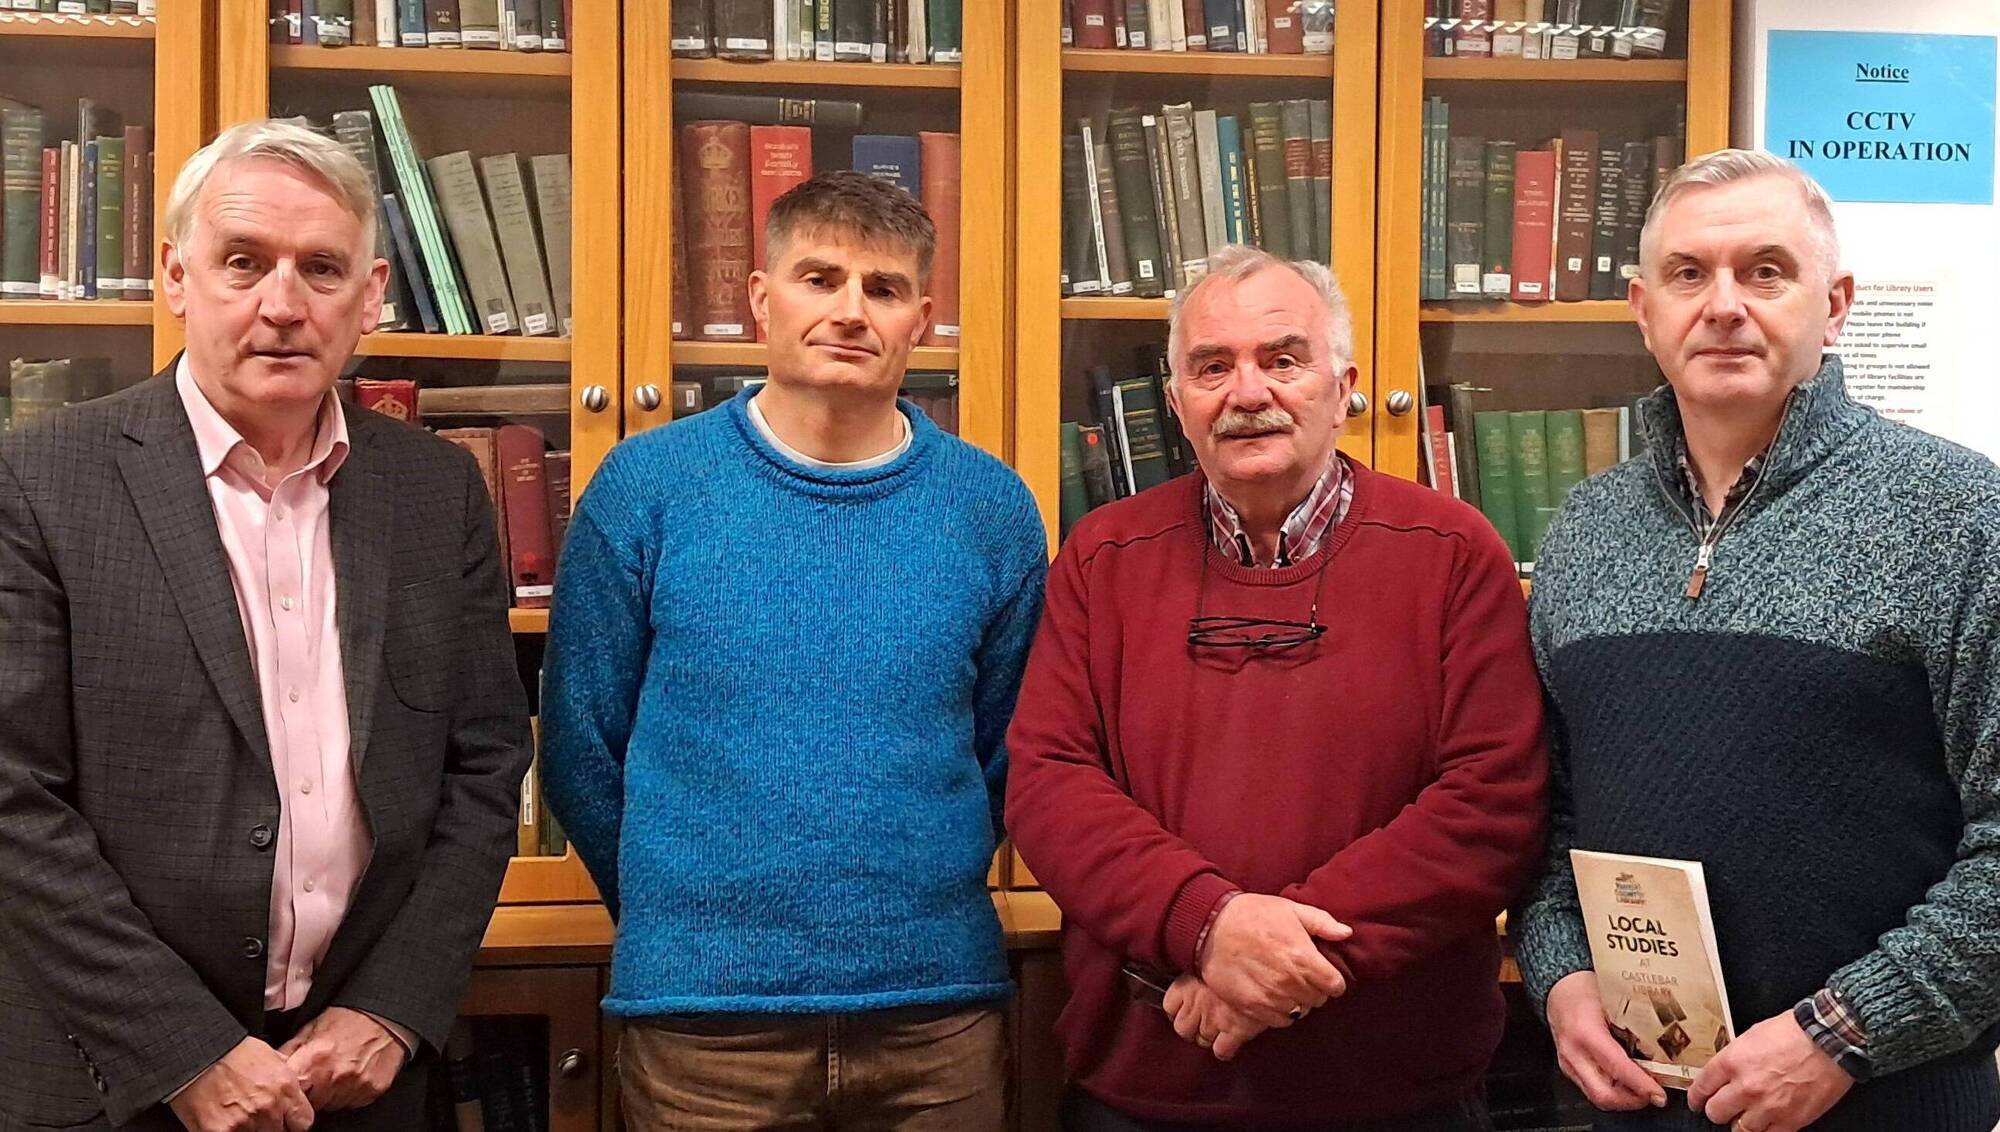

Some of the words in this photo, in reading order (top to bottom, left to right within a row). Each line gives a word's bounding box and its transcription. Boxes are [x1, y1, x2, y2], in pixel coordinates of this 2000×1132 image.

[1856, 63, 1910, 83] Notice
[1846, 111, 1916, 131] CCTV
[1788, 140, 1815, 159] IN
[1822, 140, 1972, 162] OPERATION
[1886, 284, 1912, 293] Library
[1913, 284, 1934, 292] Users
[1607, 914, 1668, 937] LOCAL
[1606, 933, 1680, 958] STUDIES
[1639, 957, 1651, 969] AT
[1621, 970, 1680, 987] CASTLEBAR
